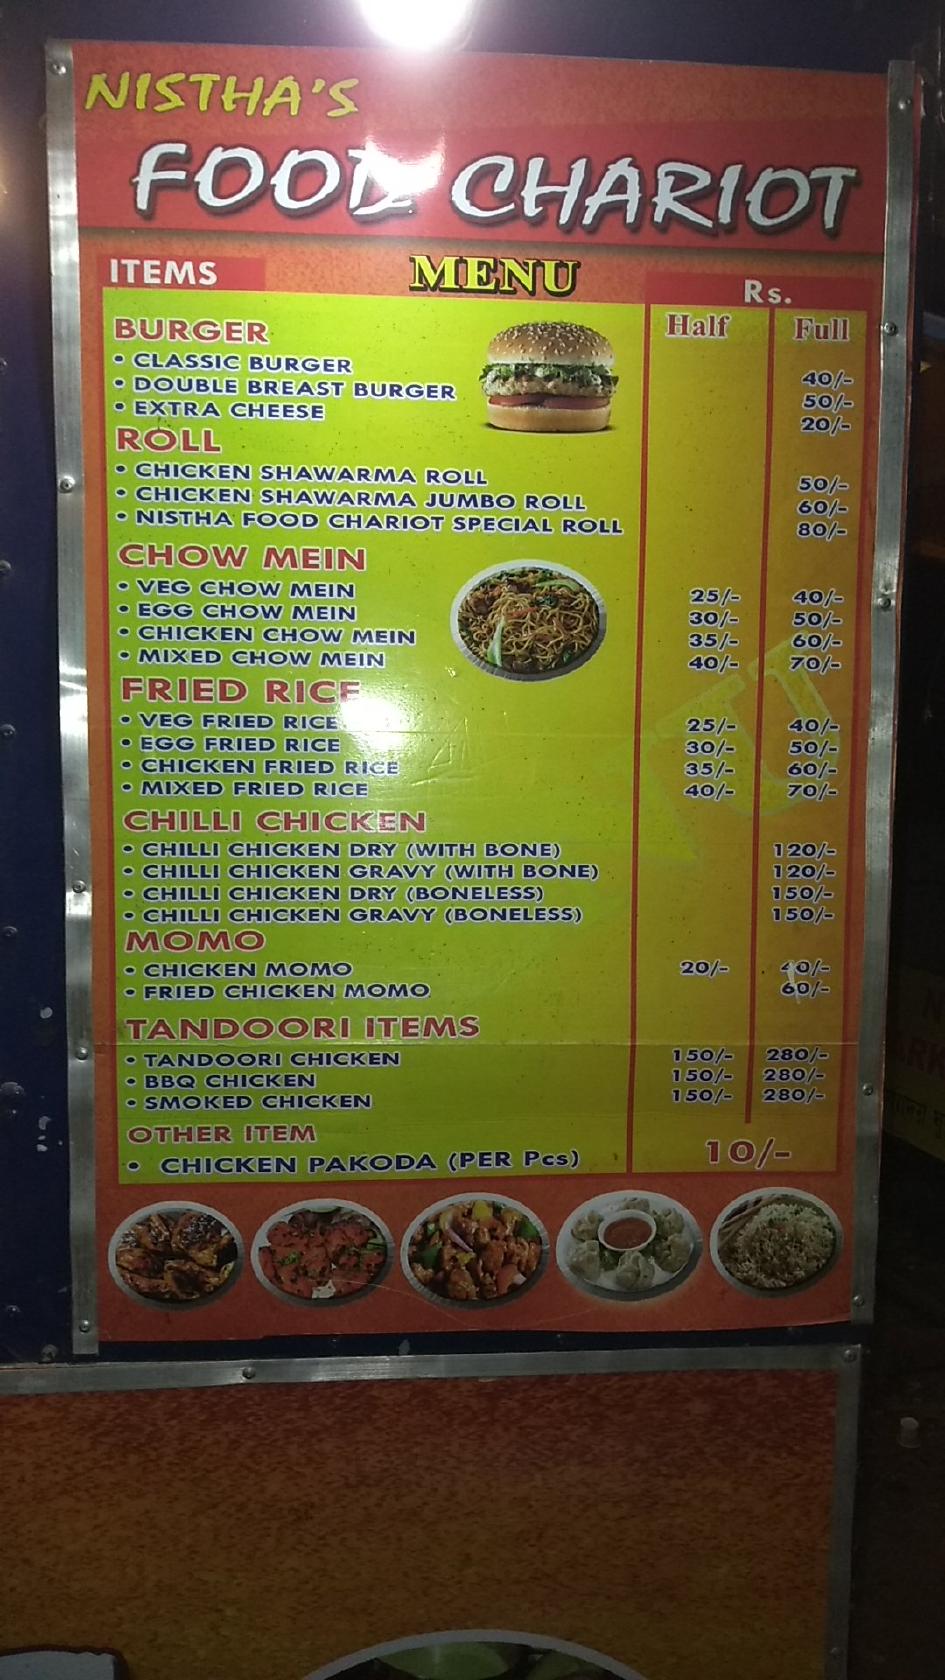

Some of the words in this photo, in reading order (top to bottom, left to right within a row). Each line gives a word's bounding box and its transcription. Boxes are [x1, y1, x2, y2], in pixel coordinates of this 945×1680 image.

[85, 72, 359, 117] NISTHA'S
[451, 155, 857, 230] CHARIOT
[110, 259, 217, 285] ITEMS
[409, 254, 580, 297] MENU
[744, 279, 792, 304] Rs.
[114, 318, 269, 343] BURGER
[667, 315, 730, 338] Half
[794, 318, 849, 340] Full
[134, 353, 239, 370] CLASSIC
[249, 356, 352, 374] BURGER
[134, 377, 237, 394] DOUBLE
[248, 380, 344, 397] BREAST
[354, 382, 455, 399] BURGER
[802, 370, 852, 389] 40/-
[135, 402, 220, 417] EXTRA
[230, 403, 324, 419] CHEESE
[802, 394, 852, 412] 50/-
[801, 417, 850, 435] 20/-
[117, 428, 221, 452] ROLL
[136, 464, 250, 480] CHICKEN
[261, 466, 416, 484] SHAWARMA
[427, 470, 487, 485] ROLL
[800, 477, 848, 494] 50/-
[136, 487, 250, 502] CHICKEN
[262, 489, 414, 507] SHAWARMA
[425, 493, 515, 509] JUMBO
[526, 495, 585, 510] ROLL
[798, 500, 847, 517] 60/-
[137, 510, 232, 526] NISTHA
[243, 512, 319, 528] FOOD
[329, 514, 444, 531] CHARIOT
[453, 516, 552, 532] SPECIAL
[563, 519, 622, 533] ROLL
[797, 522, 846, 540] 80/-
[118, 544, 248, 569] CHOW
[263, 547, 365, 571] MEIN
[137, 580, 190, 594] VEG
[200, 581, 280, 596] CHOW
[290, 583, 354, 597] MEIN
[690, 588, 740, 606] 25/-
[793, 590, 843, 606] 40/-
[138, 604, 192, 617] EGG
[203, 605, 281, 619] CHOW
[292, 606, 355, 620] MEIN
[689, 611, 738, 628] 30/-
[793, 612, 841, 628] 50/-
[139, 626, 252, 641] CHICKEN
[263, 628, 342, 643] CHOW
[352, 630, 415, 644] MEIN
[689, 633, 738, 650] 35/-
[792, 633, 842, 650] 60/-
[139, 650, 221, 664] MIXED
[232, 650, 311, 666] CHOW
[320, 652, 384, 666] MEIN
[689, 655, 738, 673] 40/-
[790, 656, 840, 673] 70/-
[122, 677, 247, 702] FRIED
[140, 713, 192, 727] VEG
[202, 714, 273, 729] FRIED
[284, 716, 337, 729] RICE
[688, 718, 736, 735] 25/-
[789, 718, 839, 735] 40/-
[141, 737, 194, 751] EGG
[205, 737, 275, 751] FRIED
[285, 738, 339, 752] RICE
[686, 740, 734, 757] 30/-
[789, 740, 838, 757] 50/-
[142, 759, 254, 774] CHICKEN
[265, 760, 334, 774] FRIED
[345, 760, 398, 774] RICE
[686, 762, 734, 778] 35/-
[788, 762, 837, 779] 60/-
[142, 781, 223, 795] MIXED
[234, 782, 303, 796] FRIED
[314, 782, 368, 796] RICE
[685, 783, 734, 801] 40/-
[788, 784, 837, 800] 70/-
[124, 810, 241, 831] CHILLI
[256, 811, 426, 832] CHICKEN
[142, 843, 218, 857] CHILLI
[228, 843, 340, 857] CHICKEN
[350, 843, 398, 857] DRY
[407, 843, 474, 858] (WITH
[486, 844, 560, 858] BONE)
[774, 843, 836, 860] 120/-
[143, 864, 219, 879] CHILLI
[229, 864, 340, 879] CHICKEN
[349, 864, 435, 879] GRAVY
[445, 864, 513, 880] (WITH
[523, 864, 598, 880] BONE)
[773, 864, 835, 880] 120/-
[143, 887, 219, 901] CHILLI
[229, 887, 340, 901] CHICKEN
[350, 887, 396, 901] DRY
[407, 886, 543, 902] (BONELESS)
[772, 886, 832, 902] 150/-
[143, 909, 219, 922] CHILLI
[229, 908, 339, 922] CHICKEN
[349, 908, 435, 922] GRAVY
[445, 908, 582, 923] (BONELESS)
[773, 907, 833, 924] 150/-
[126, 930, 265, 952] MOMO
[144, 963, 256, 978] CHICKEN
[265, 962, 352, 977] MOMO
[681, 960, 728, 977] 20/-
[144, 985, 215, 999] FRIED
[225, 984, 334, 999] CHICKEN
[344, 983, 430, 998] MOMO
[782, 982, 829, 997] 60/-
[126, 1017, 349, 1040] TANDOORI
[366, 1016, 480, 1039] ITEMS
[145, 1053, 281, 1068] TANDOORI
[290, 1052, 399, 1066] CHICKEN
[673, 1049, 733, 1064] 150/-
[766, 1047, 827, 1063] 280/-
[145, 1075, 195, 1089] BBQ
[206, 1074, 315, 1088] CHICKEN
[673, 1069, 733, 1084] 150/-
[764, 1068, 824, 1083] 280/-
[145, 1096, 252, 1110] SMOKED
[262, 1095, 370, 1108] CHICKEN
[673, 1089, 732, 1104] 150/-
[764, 1088, 824, 1103] 280/-
[128, 1126, 231, 1143] OTHER
[246, 1125, 316, 1142] ITEM
[161, 1157, 296, 1174] CHICKEN
[309, 1154, 437, 1174] PAKODA
[450, 1152, 512, 1170] (PER
[525, 1150, 579, 1168] Pcs)
[706, 1138, 791, 1169] 10/-
